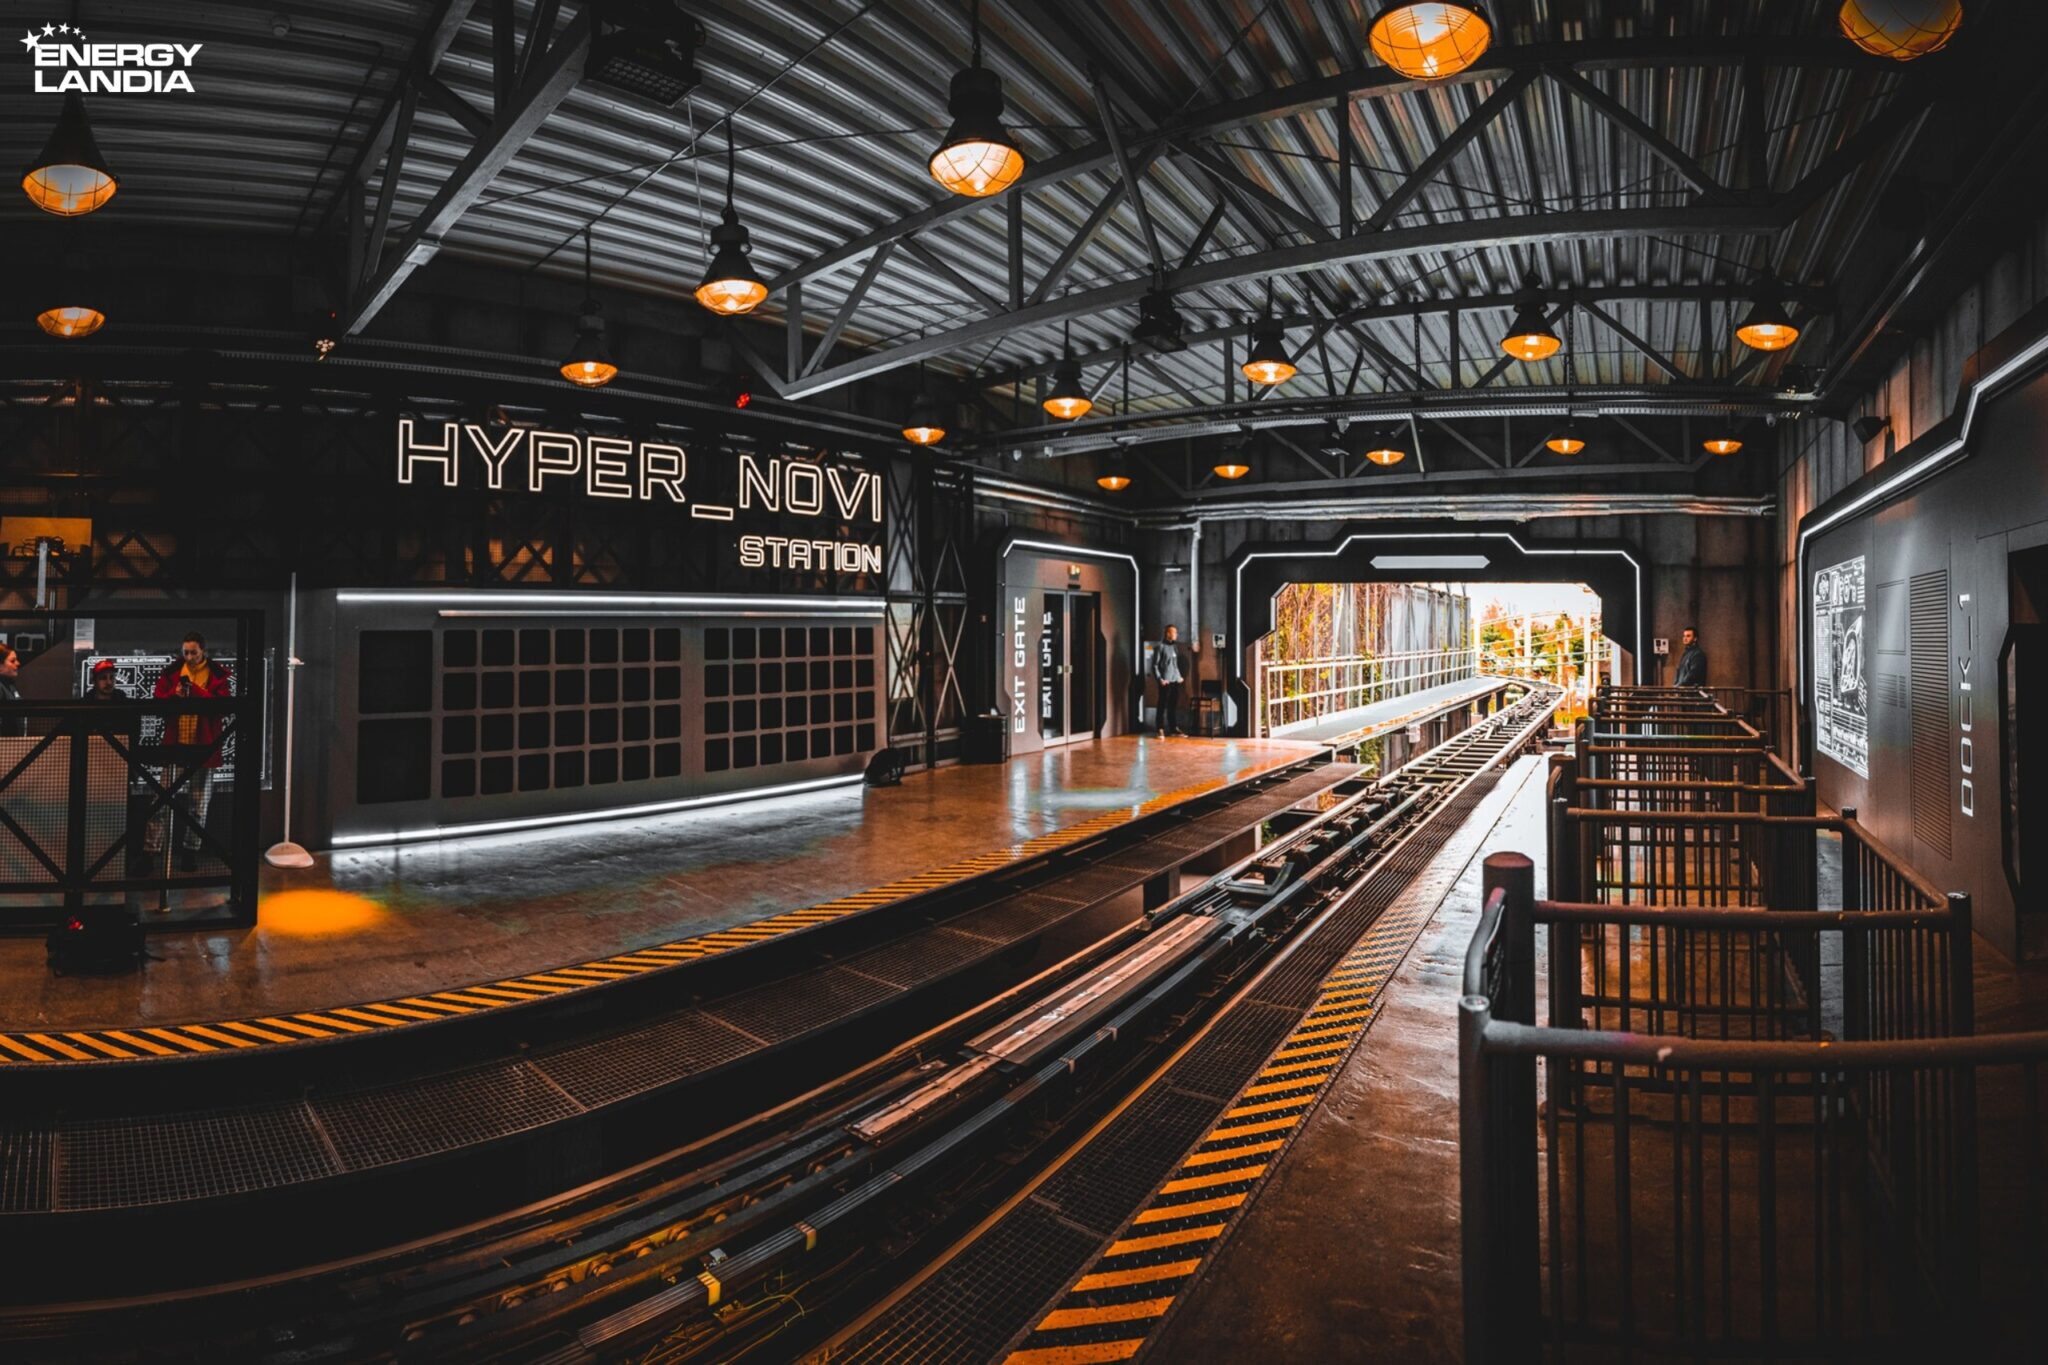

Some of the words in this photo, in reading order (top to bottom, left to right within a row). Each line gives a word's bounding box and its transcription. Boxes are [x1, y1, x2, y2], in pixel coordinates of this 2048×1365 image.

[740, 535, 881, 574] STATION
[1014, 597, 1026, 668] GATE
[1014, 675, 1026, 734] EXIT
